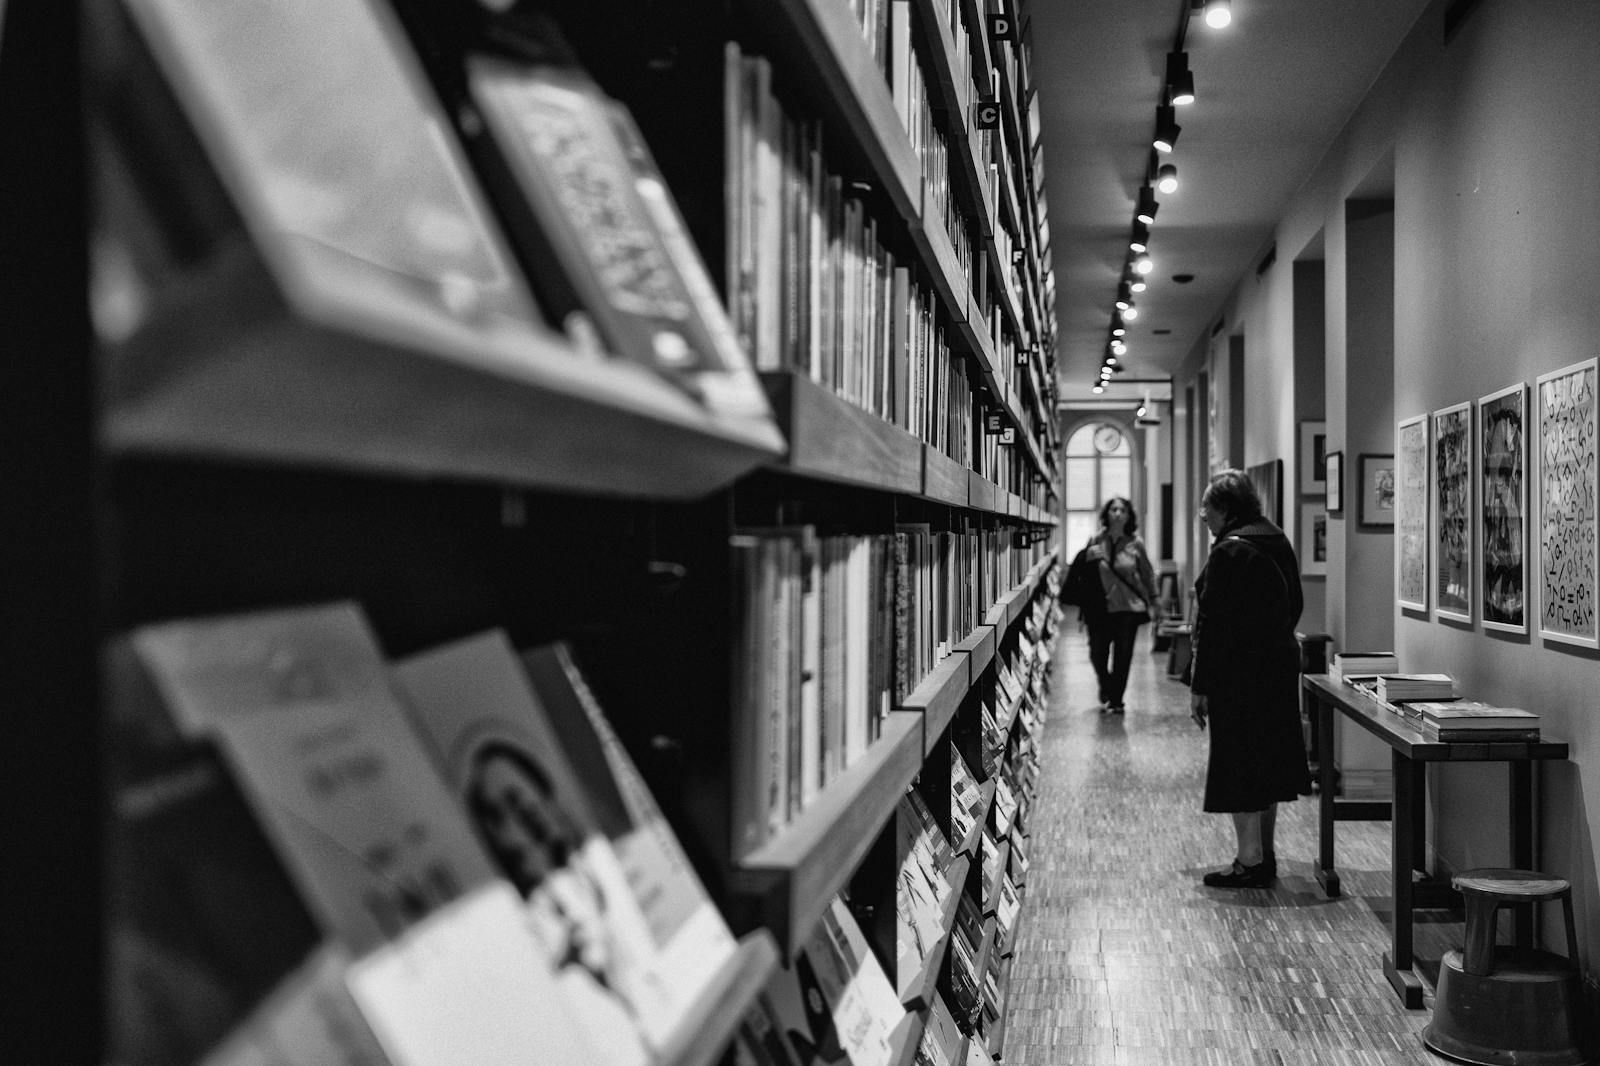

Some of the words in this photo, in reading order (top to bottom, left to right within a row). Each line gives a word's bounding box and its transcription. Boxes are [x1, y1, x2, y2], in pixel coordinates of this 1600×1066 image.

[995, 19, 1009, 35] D
[981, 107, 997, 123] C
[1013, 251, 1023, 262] F
[1017, 352, 1028, 364] H
[988, 415, 1000, 430] E
